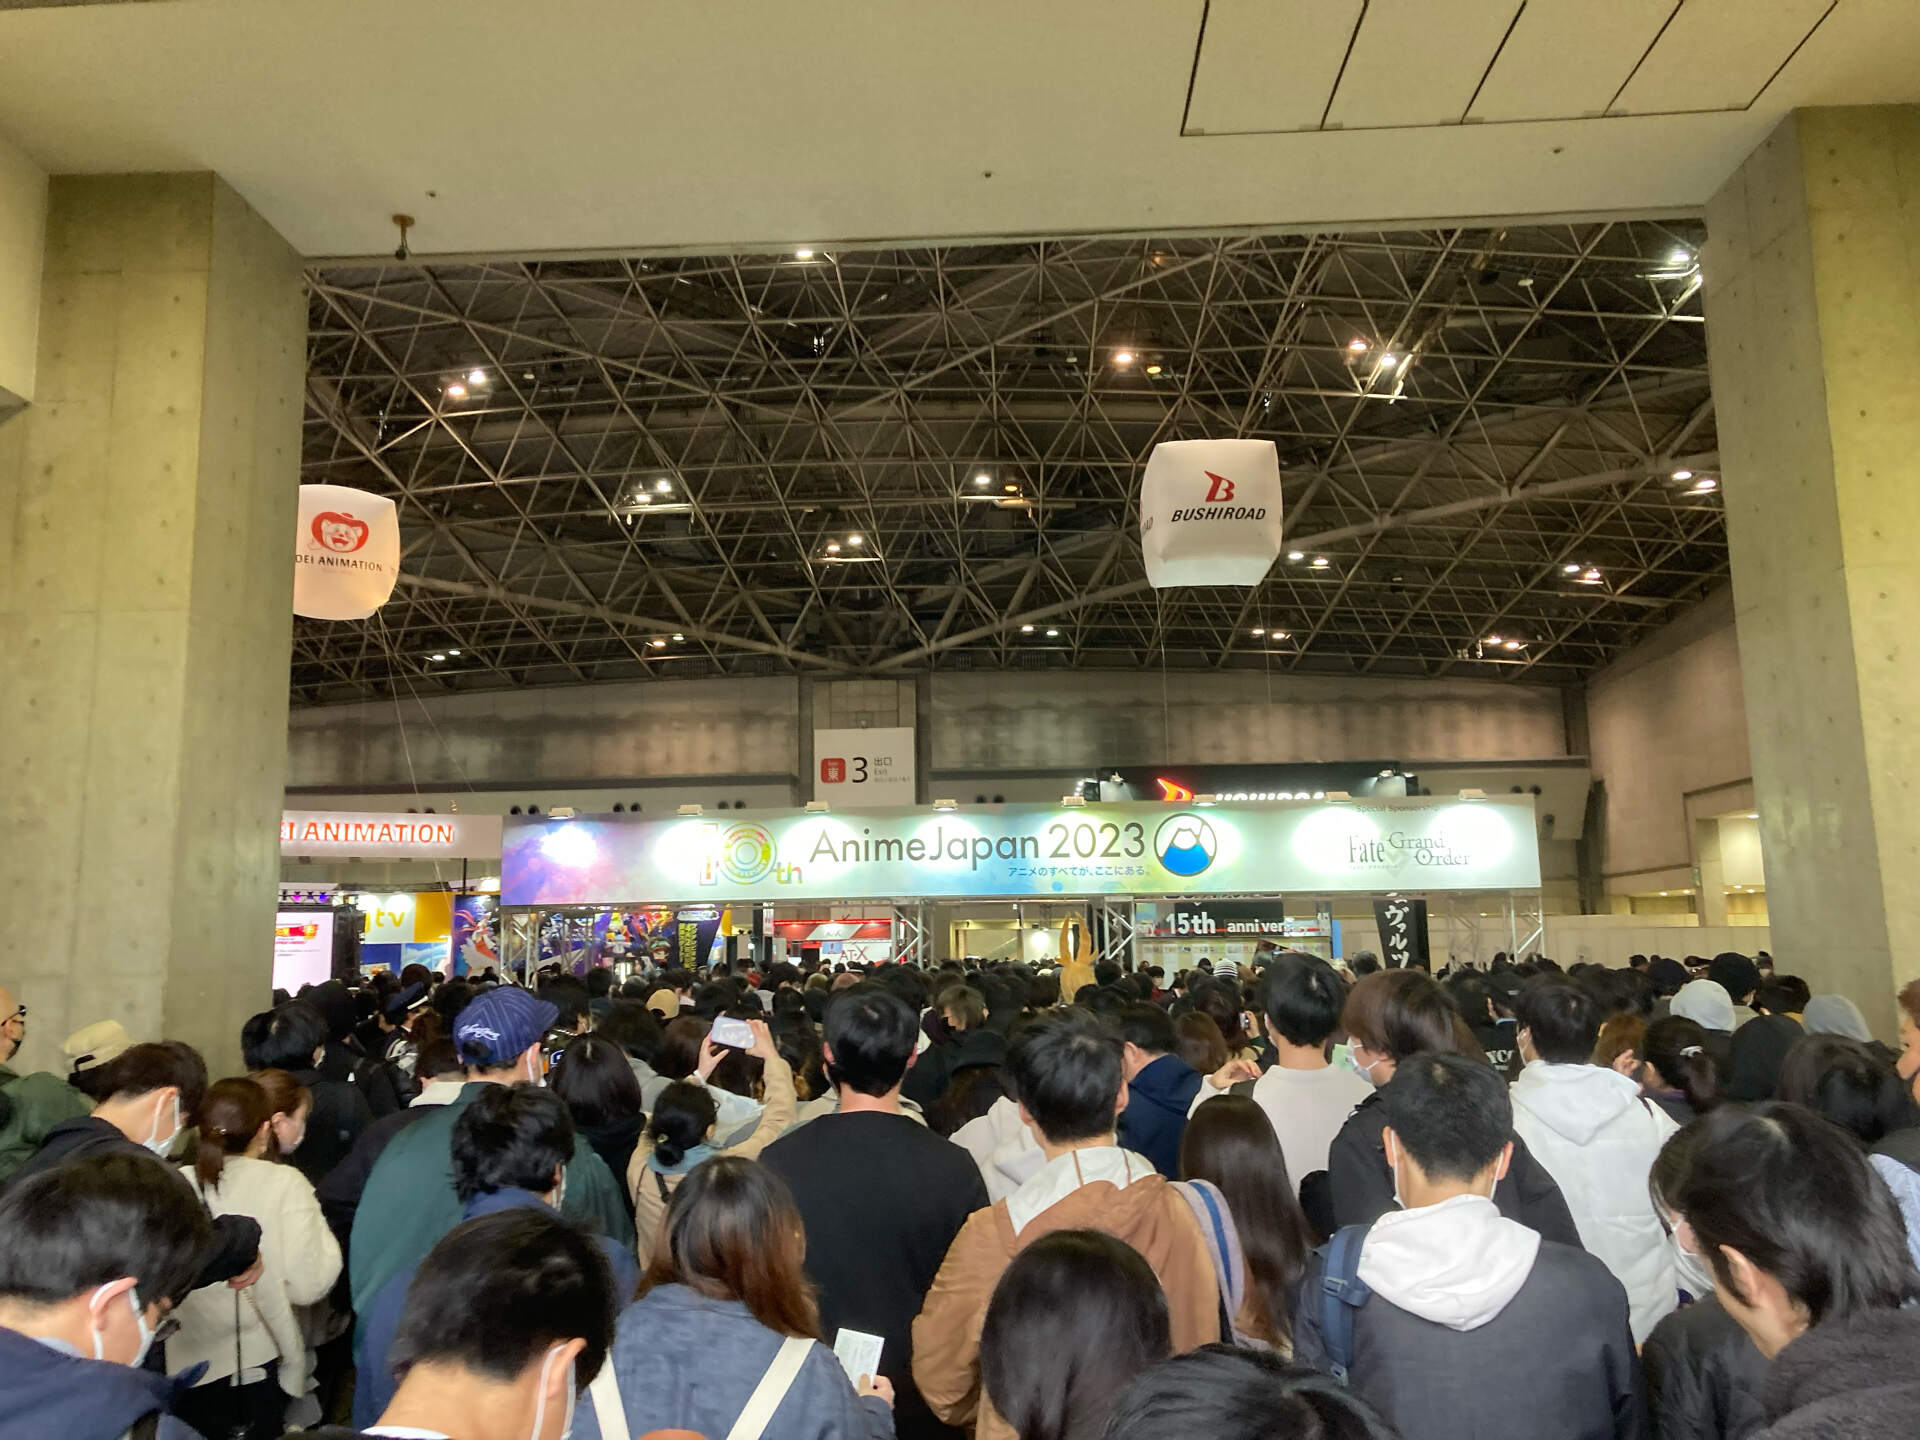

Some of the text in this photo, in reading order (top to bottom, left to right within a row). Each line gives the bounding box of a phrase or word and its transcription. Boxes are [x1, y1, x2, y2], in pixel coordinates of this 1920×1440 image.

[1171, 507, 1266, 522] BUSHIROAD
[319, 556, 382, 571] ANIMATION
[852, 757, 868, 783] 3
[874, 757, 892, 766] 出口
[303, 822, 453, 844] ANIMATION
[809, 826, 1039, 871] AnimeJapan
[1049, 822, 1145, 858] 2023
[1349, 831, 1446, 863] Fate Grand
[1414, 848, 1471, 865] Order
[1008, 866, 1149, 877] アニメのすべてが、ここにある。
[1166, 911, 1216, 935] 15th
